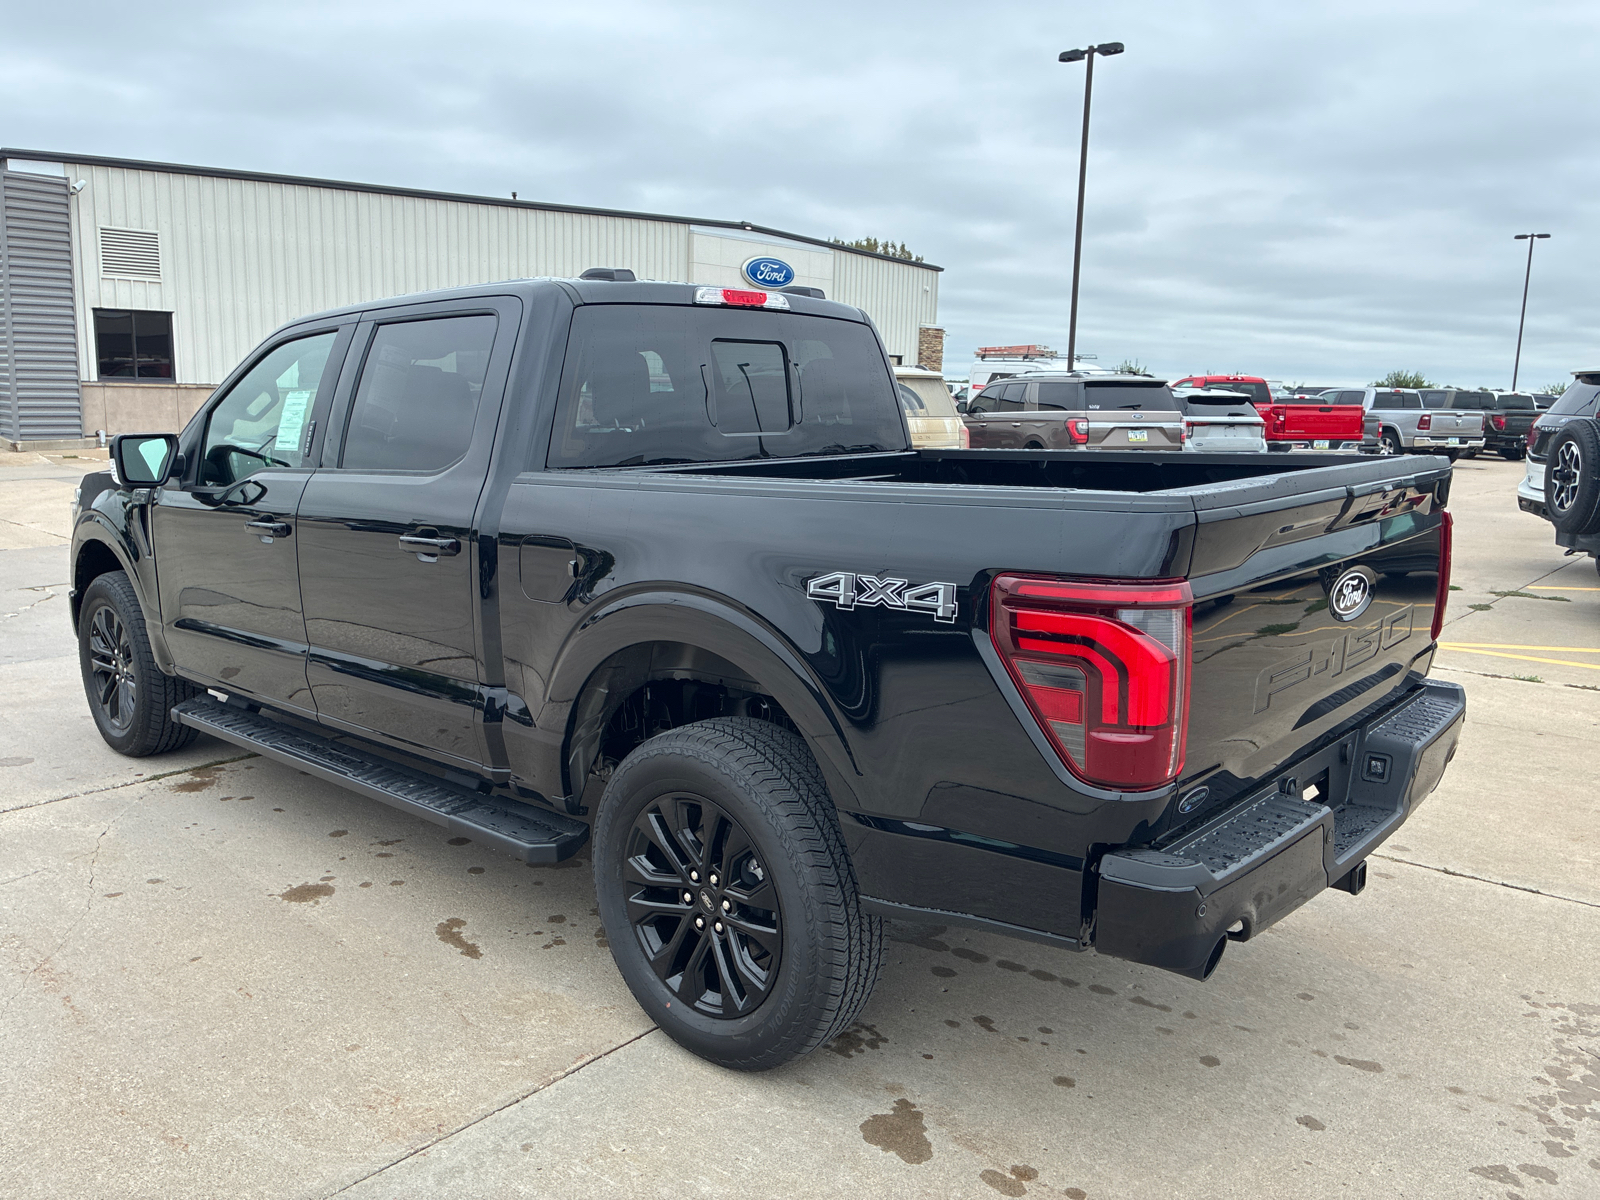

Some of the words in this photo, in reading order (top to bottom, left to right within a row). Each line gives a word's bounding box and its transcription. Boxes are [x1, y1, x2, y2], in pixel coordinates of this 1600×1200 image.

[757, 262, 786, 282] Ford
[1340, 578, 1364, 608] Ford
[1253, 603, 1415, 715] F-150
[700, 890, 715, 912] Ford
